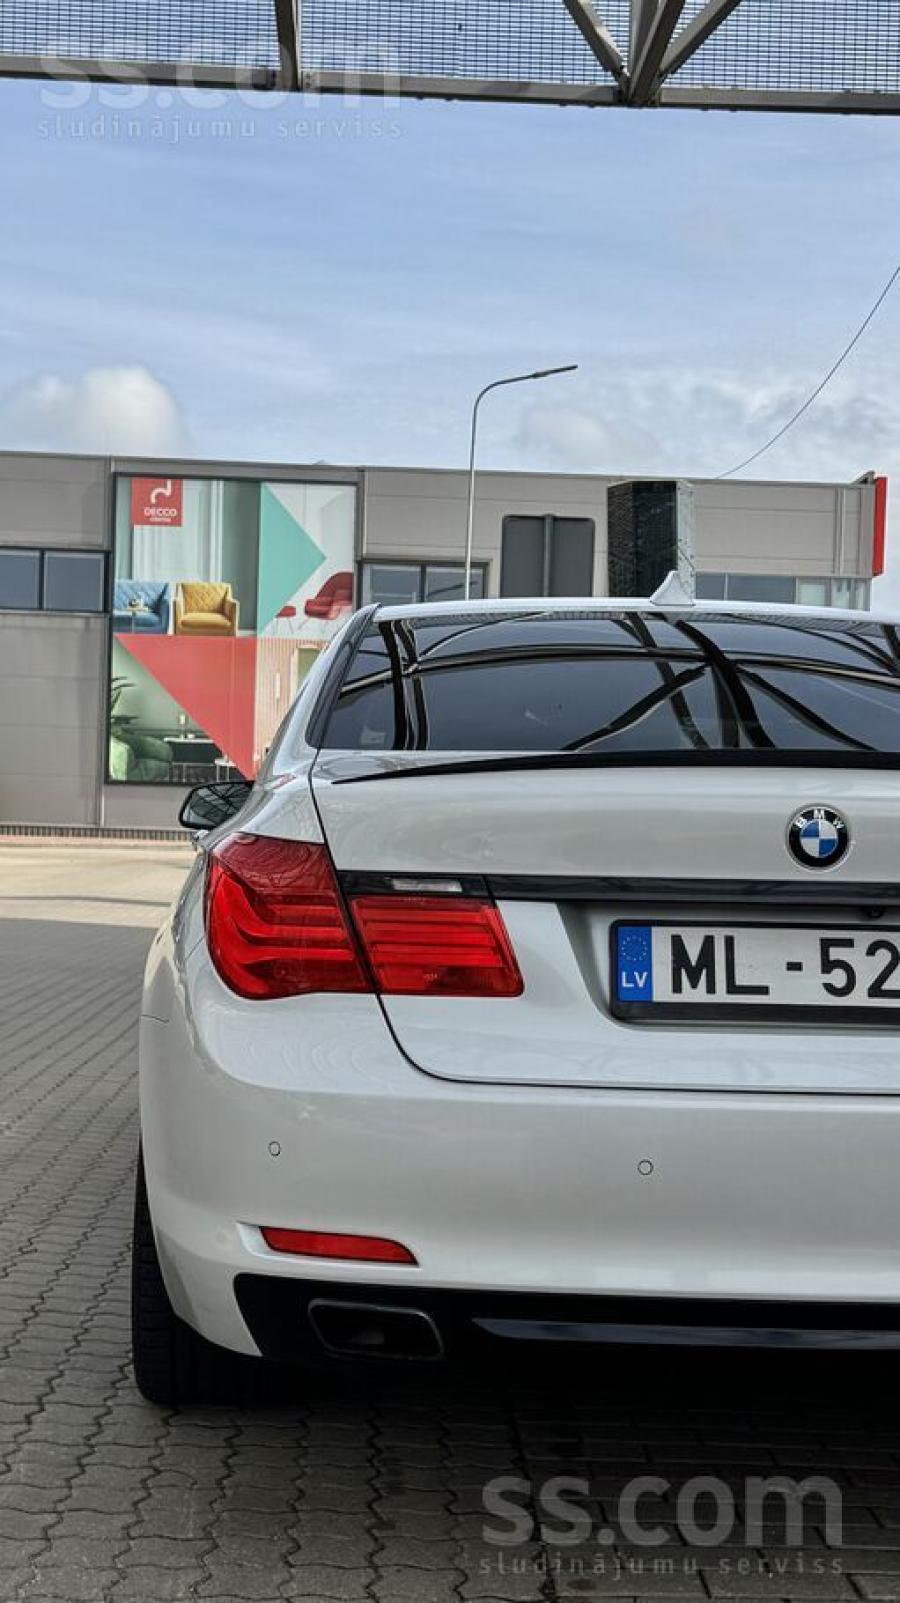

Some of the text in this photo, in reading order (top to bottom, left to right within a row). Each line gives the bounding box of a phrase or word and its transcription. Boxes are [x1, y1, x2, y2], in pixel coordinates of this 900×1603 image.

[143, 507, 177, 517] DECCO
[795, 808, 845, 829] BMW
[621, 971, 648, 988] LV
